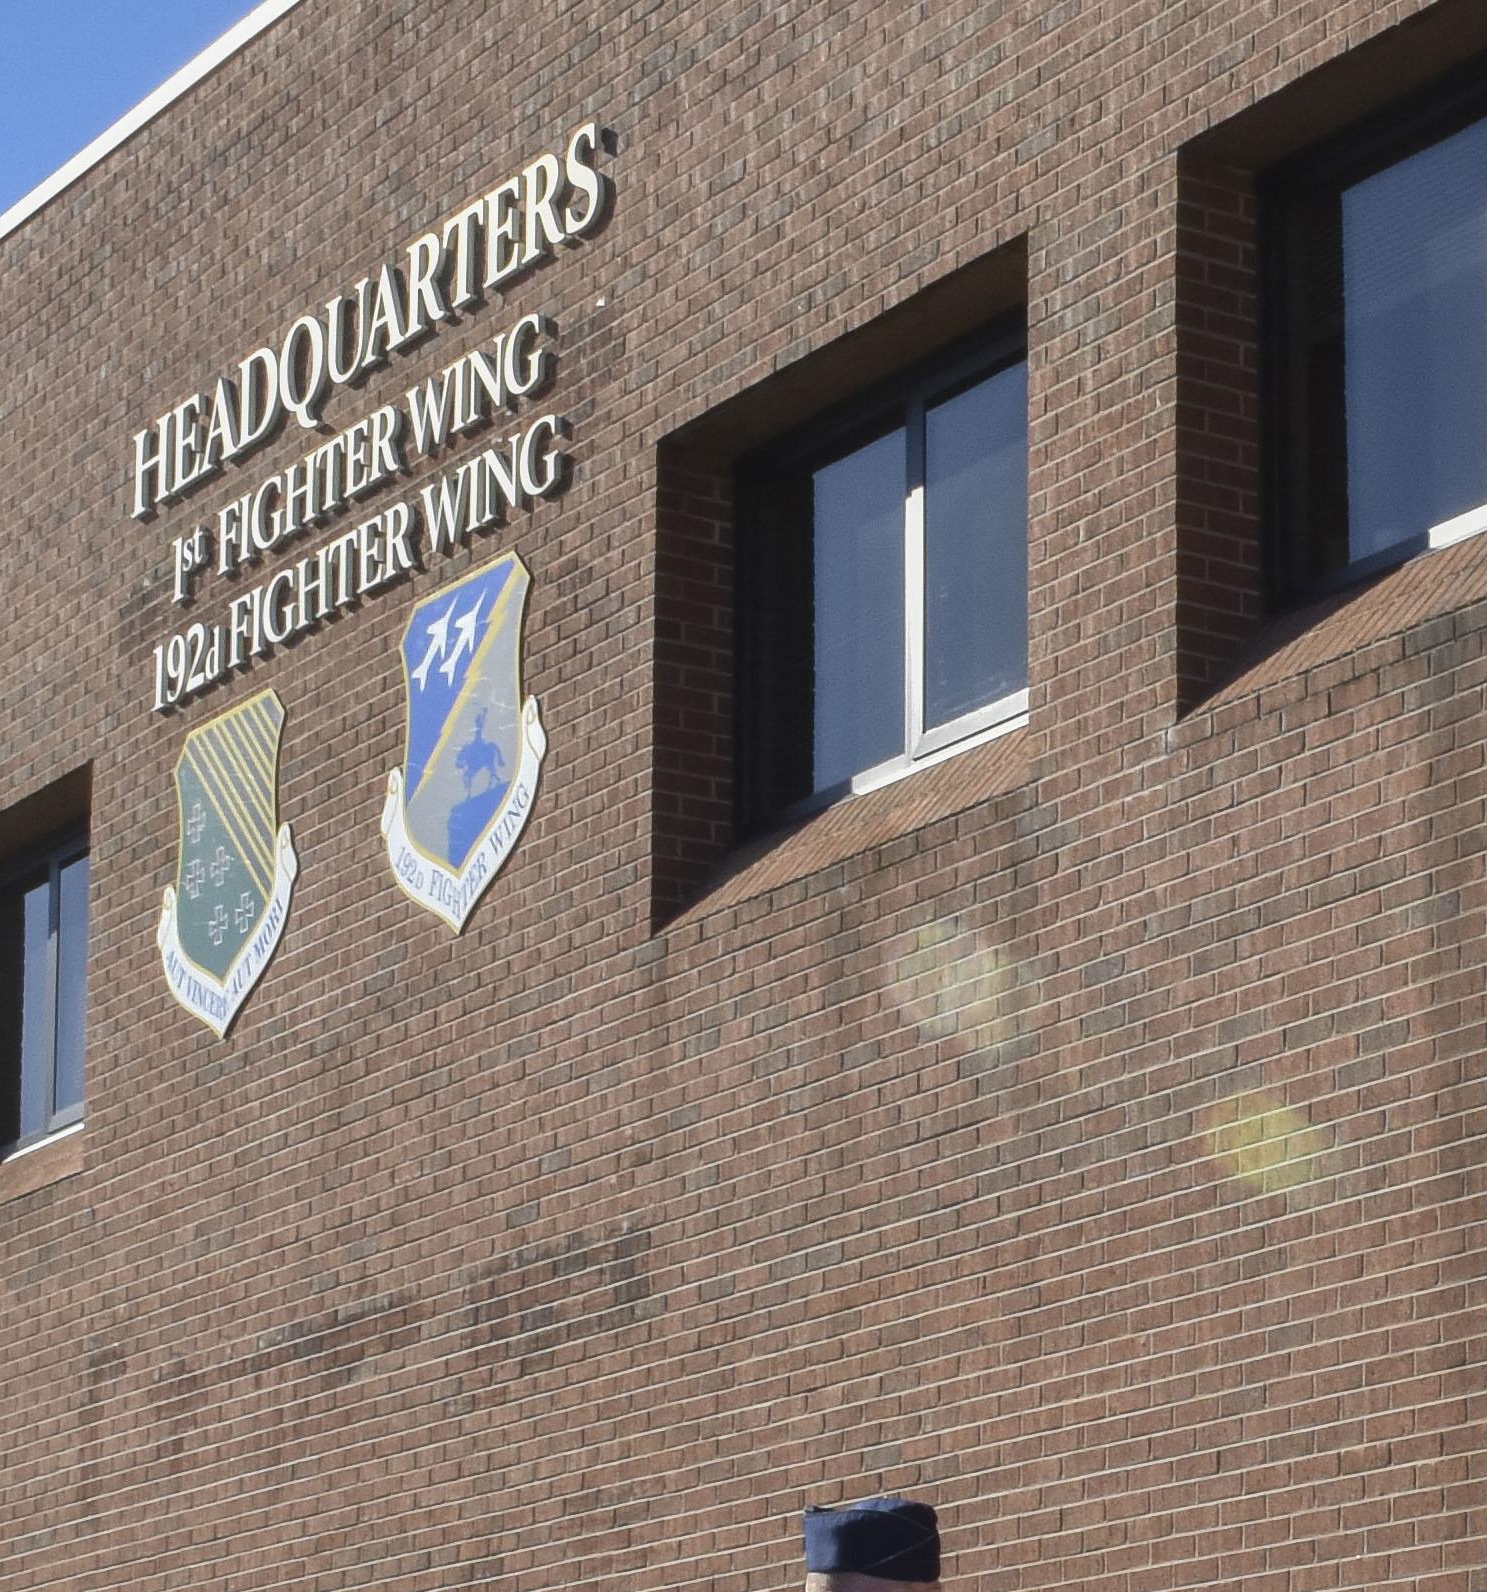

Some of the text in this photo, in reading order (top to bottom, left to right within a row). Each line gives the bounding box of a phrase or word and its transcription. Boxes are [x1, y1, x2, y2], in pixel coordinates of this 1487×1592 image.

[130, 123, 601, 519] HEADQUARTERS
[172, 313, 548, 604] 1st FIGHTER WING
[153, 415, 563, 712] 192d FIGHTER WING
[429, 853, 488, 920] FIGHTER
[489, 783, 530, 855] WING
